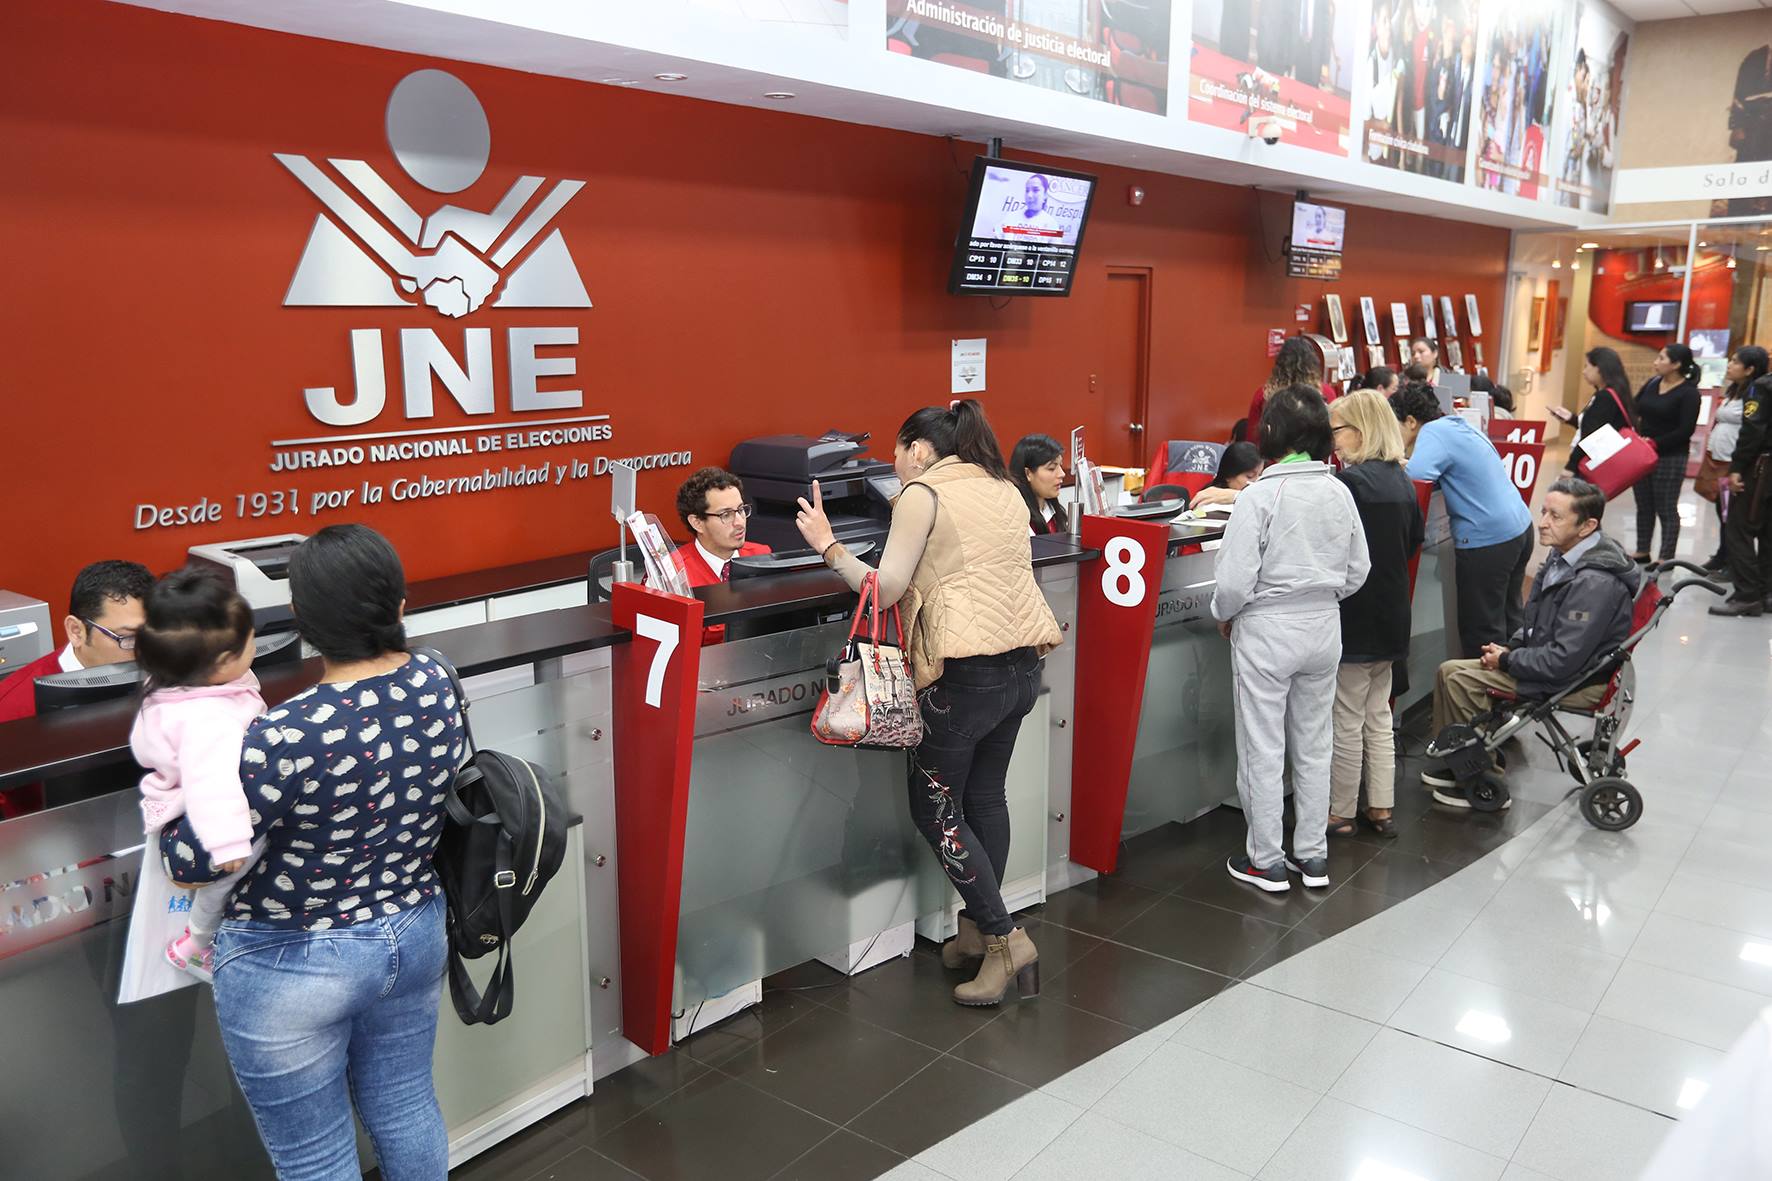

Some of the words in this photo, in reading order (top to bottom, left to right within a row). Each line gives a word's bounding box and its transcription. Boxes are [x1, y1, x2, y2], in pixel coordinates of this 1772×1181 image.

[906, 0, 1004, 38] Administración
[1007, 25, 1022, 43] de
[1023, 28, 1065, 55] justicia
[1067, 40, 1111, 67] electoral
[1286, 105, 1313, 123] electoral
[304, 326, 583, 427] JNE
[269, 446, 365, 472] JURADO
[370, 437, 472, 463] NACIONAL
[478, 434, 502, 453] DE
[506, 424, 613, 451] ELECCIONES
[1501, 452, 1536, 489] 10
[134, 497, 222, 530] Desde
[310, 489, 355, 515] por
[360, 481, 383, 506] la
[389, 462, 550, 502] Gobernabilidad
[555, 463, 568, 485] y
[571, 458, 588, 480] la
[1101, 535, 1146, 608] 8
[636, 612, 680, 709] 7
[727, 682, 806, 717] JURADO
